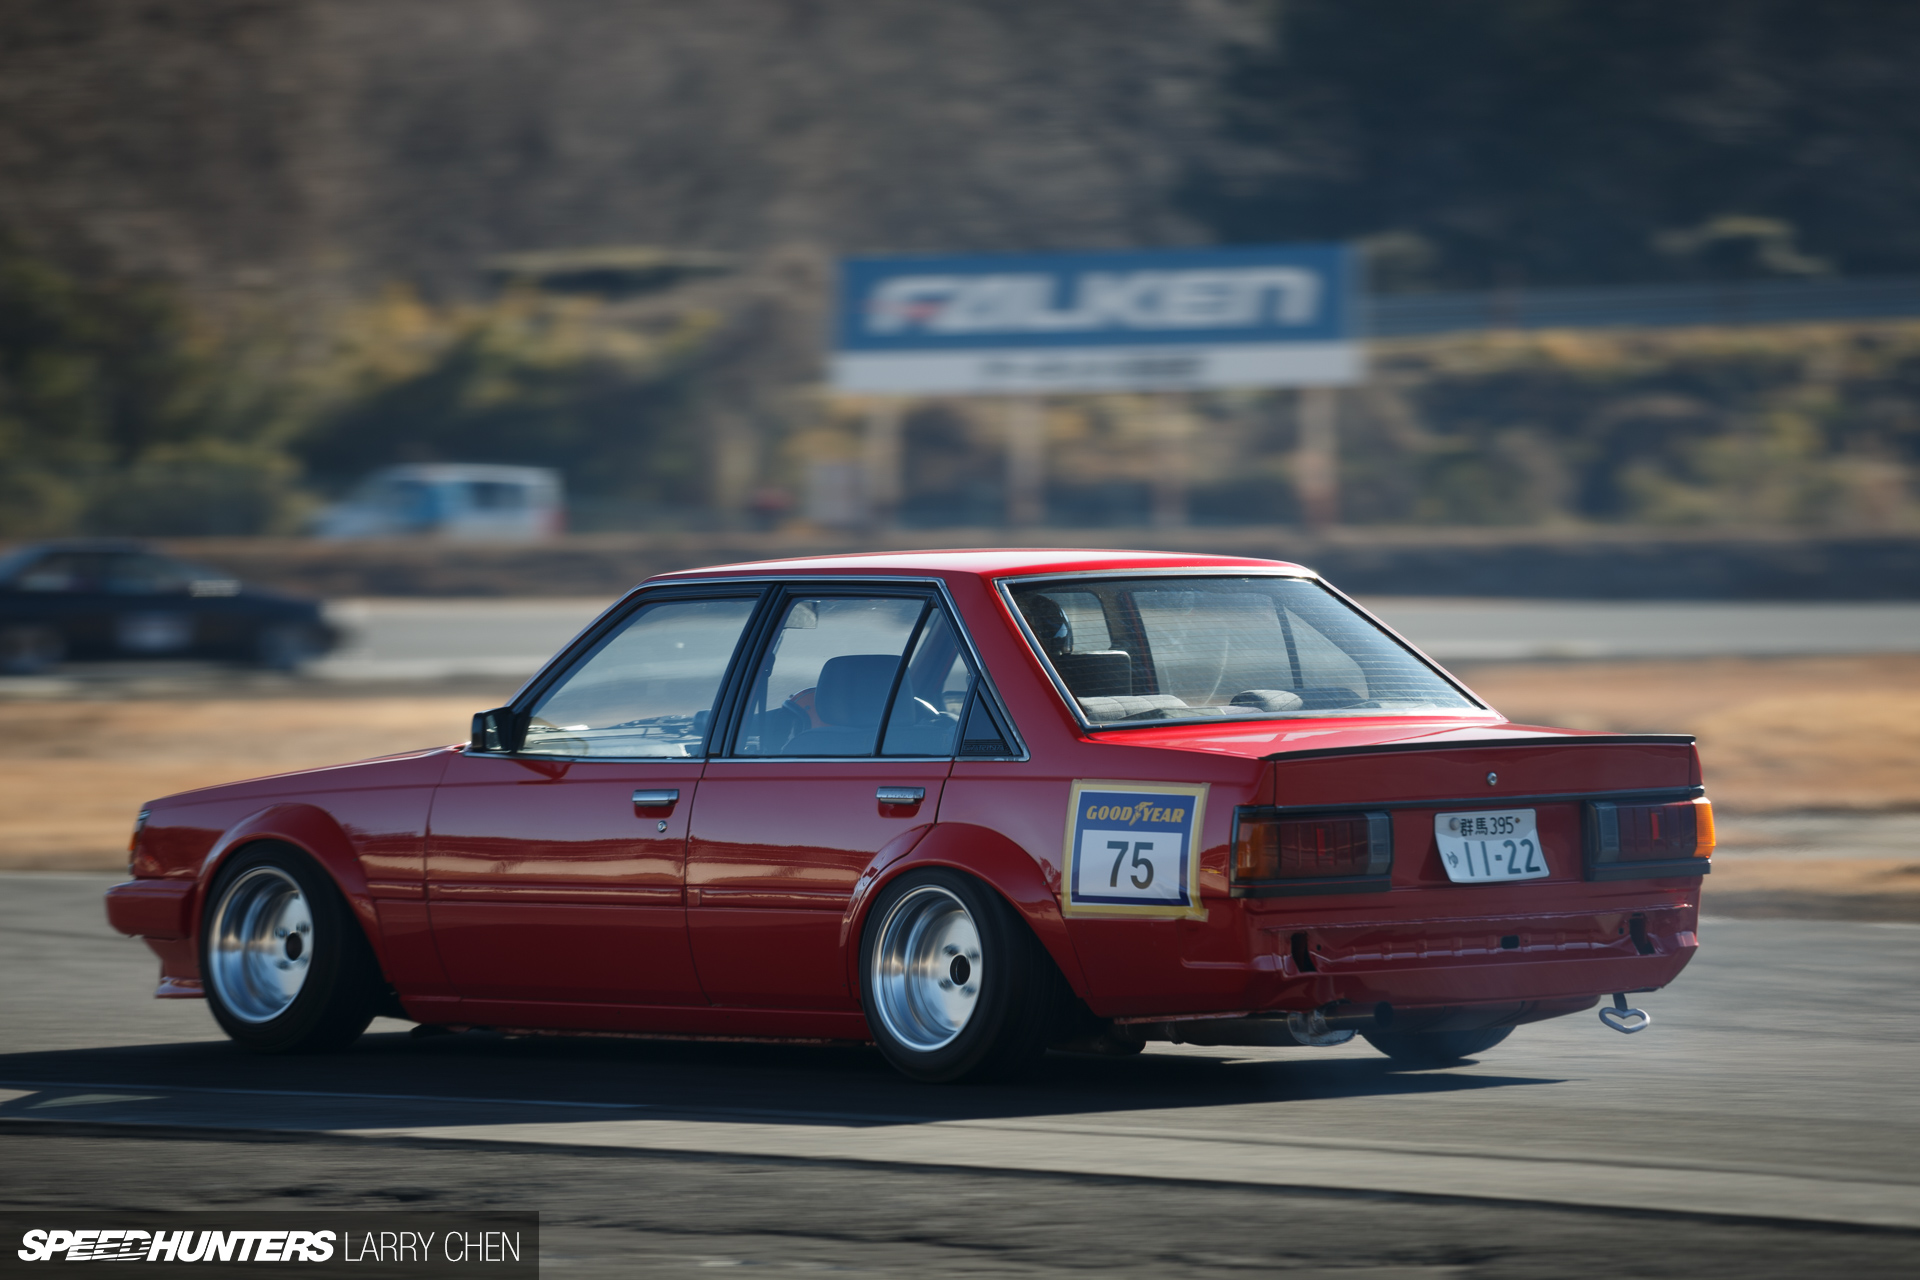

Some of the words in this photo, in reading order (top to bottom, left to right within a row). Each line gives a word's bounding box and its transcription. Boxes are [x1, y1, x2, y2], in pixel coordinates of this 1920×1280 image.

[866, 266, 1322, 334] FALKEN
[1086, 803, 1185, 823] GOODYEAR
[1107, 840, 1154, 889] 75
